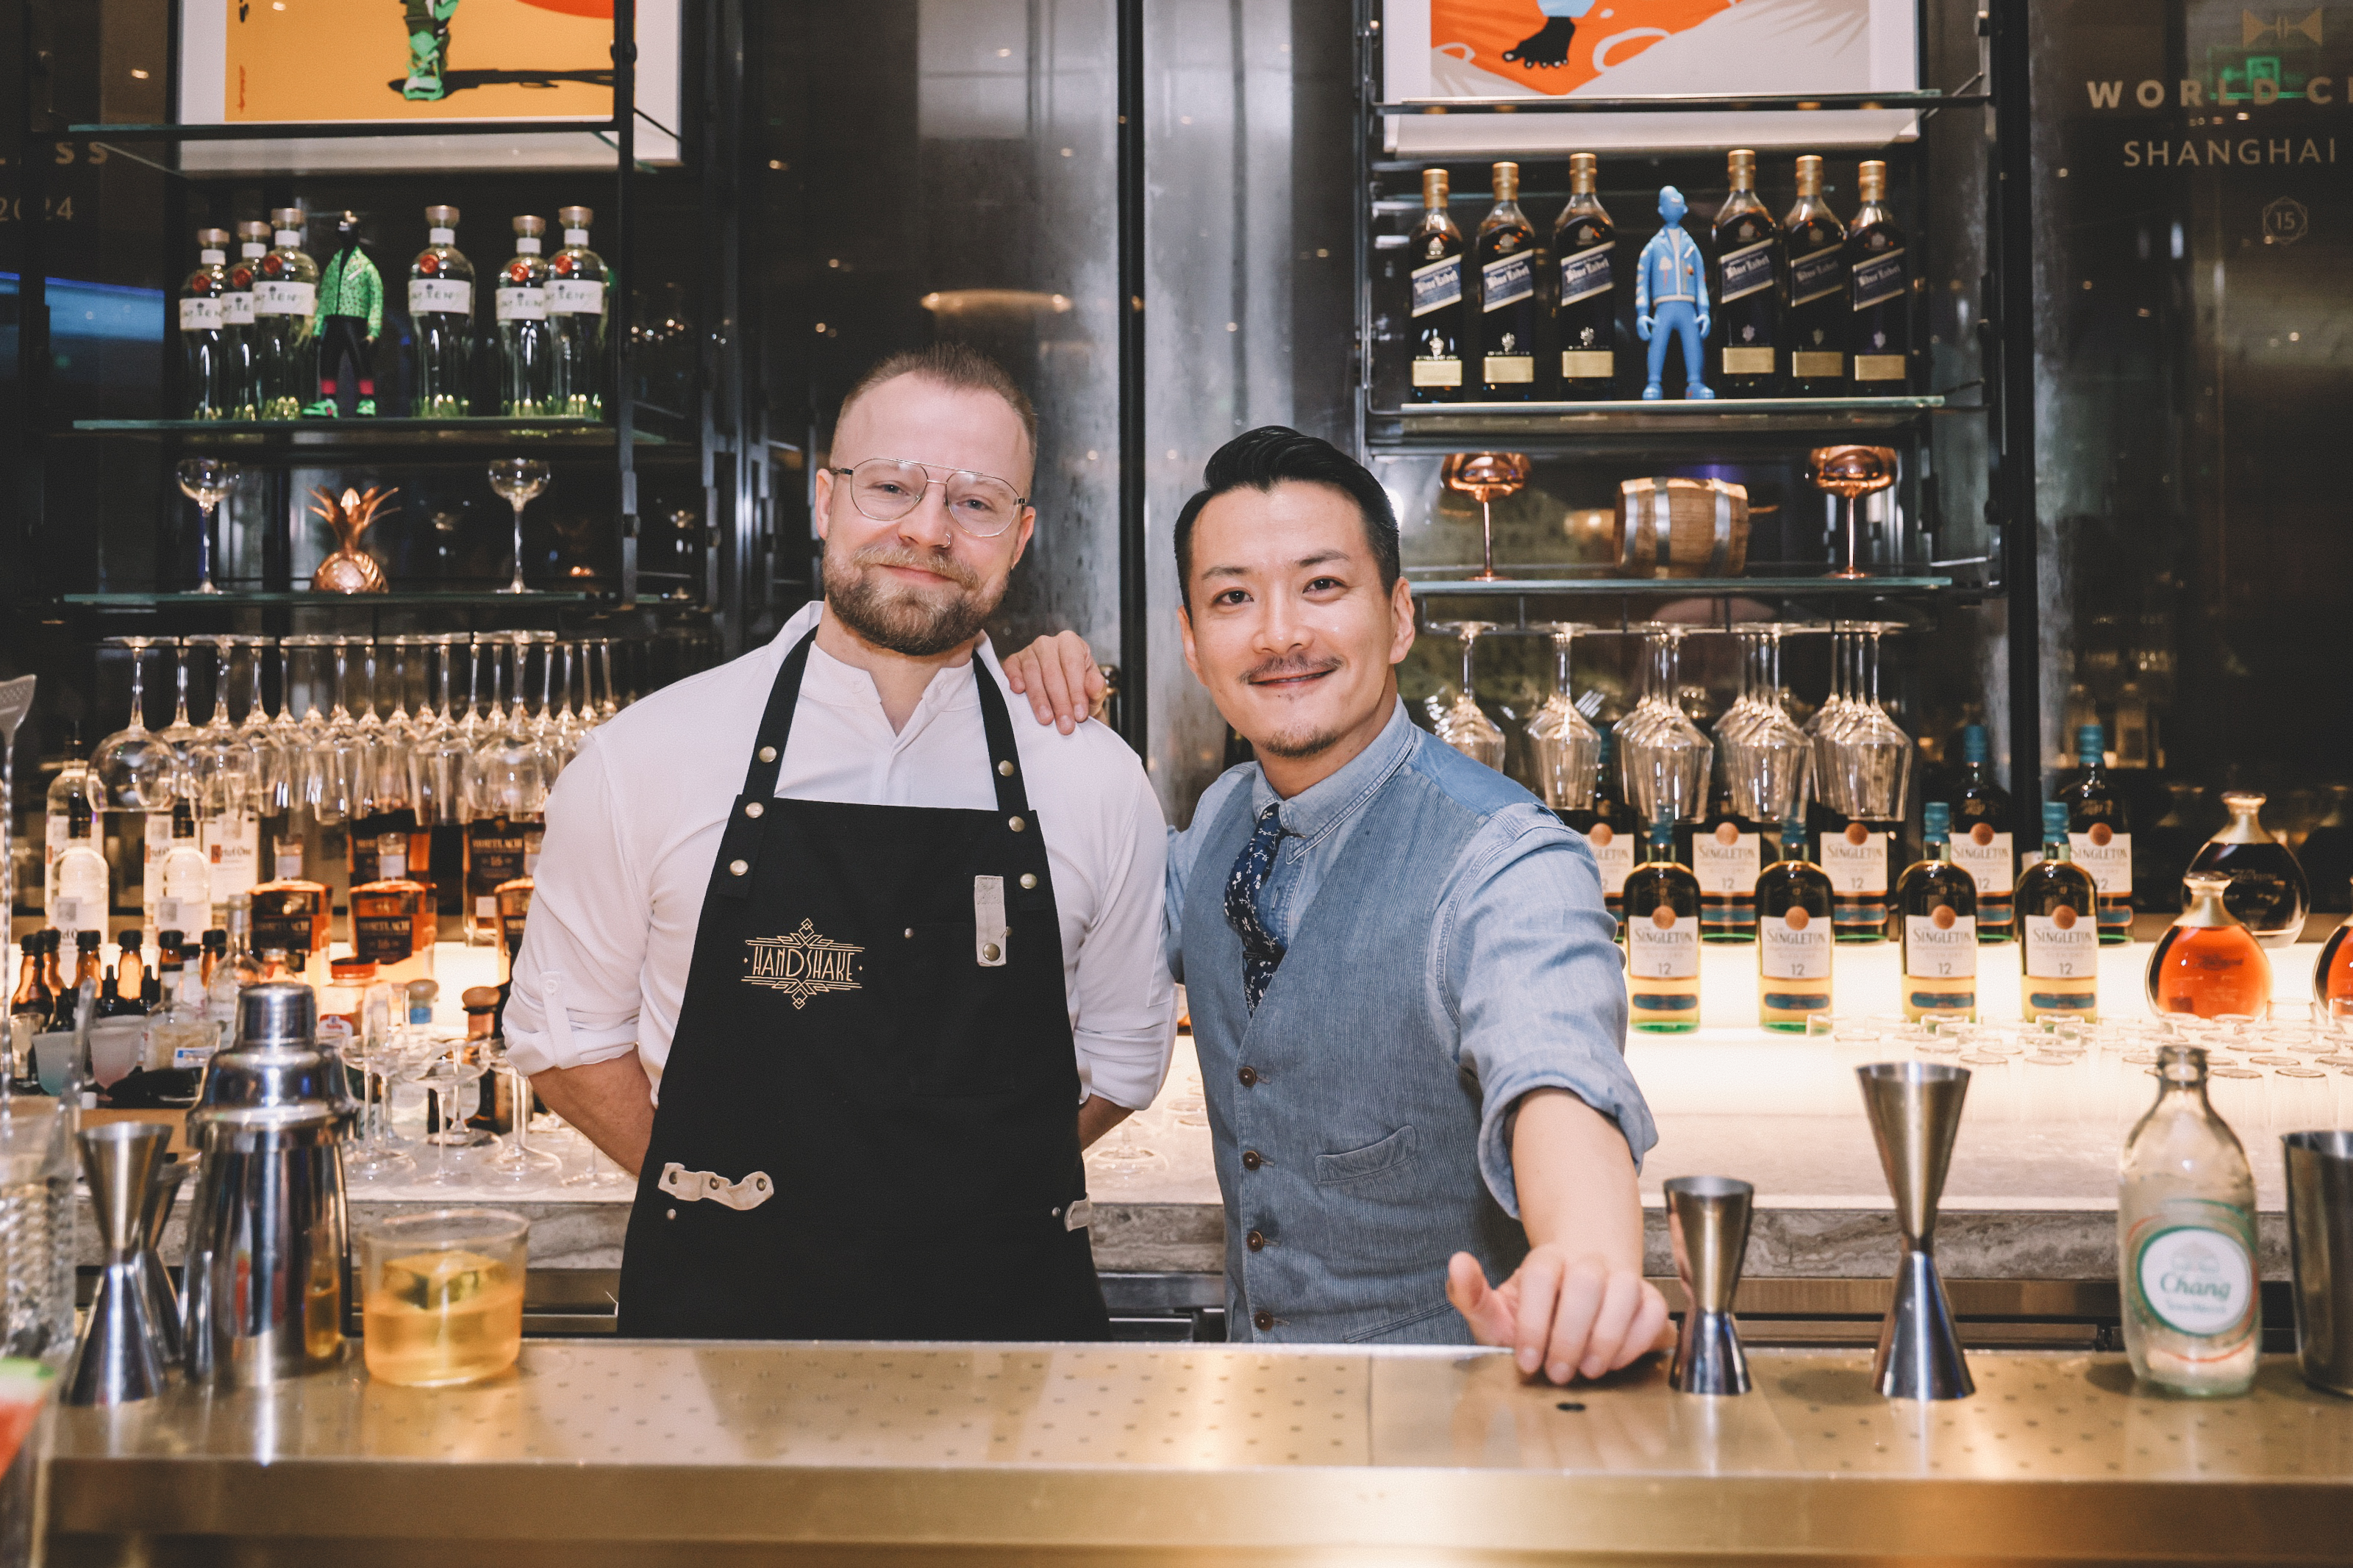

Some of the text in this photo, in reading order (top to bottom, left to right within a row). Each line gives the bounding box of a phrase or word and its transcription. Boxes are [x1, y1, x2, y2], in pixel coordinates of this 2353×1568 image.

[2086, 77, 2279, 109] WORLD
[2124, 138, 2336, 167] SHANGHAI
[1722, 877, 1735, 889] 12
[1852, 877, 1864, 889] 12
[1634, 927, 1693, 944] SINGLETON
[1766, 927, 1826, 944] SINGLETON
[1913, 927, 1972, 943] SINGLETON
[2033, 927, 2093, 944] SINGLETON
[1657, 962, 1672, 975] 12
[1790, 963, 1805, 975] 12
[1938, 962, 1952, 975] 12
[2058, 962, 2073, 975] 12
[2160, 1272, 2232, 1301] Chang
